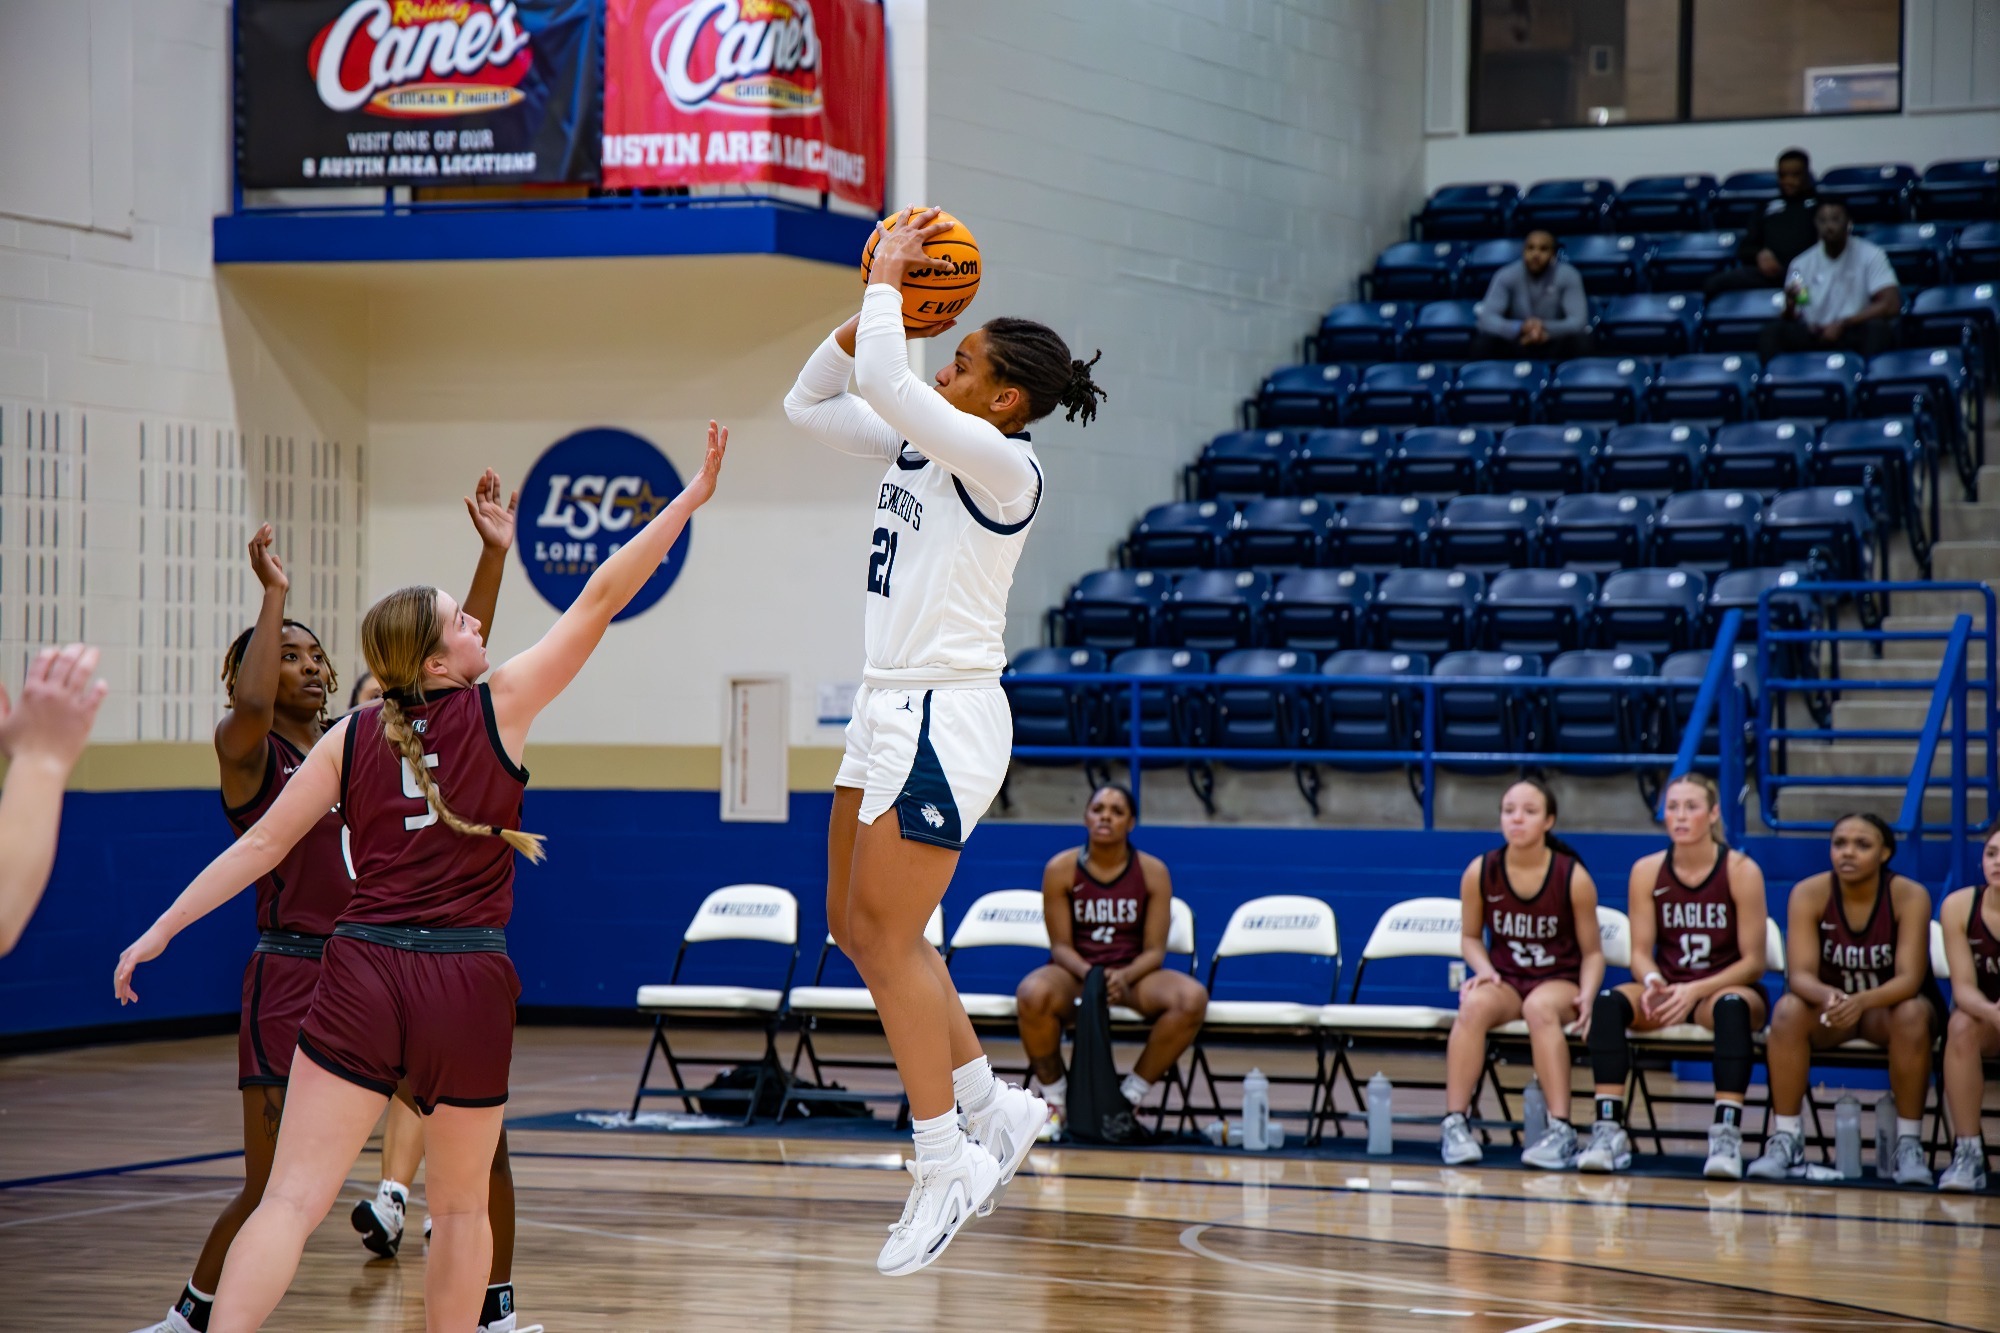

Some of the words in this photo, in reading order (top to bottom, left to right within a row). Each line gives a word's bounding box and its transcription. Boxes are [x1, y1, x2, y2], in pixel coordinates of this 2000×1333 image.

[347, 132, 391, 152] VISIT
[393, 130, 430, 151] ONE
[433, 130, 457, 151] OF
[459, 129, 494, 149] OUR
[318, 156, 386, 177] AUSTIN
[388, 155, 438, 175] AREA
[440, 153, 537, 175] LOCATIONS
[536, 474, 642, 540] LSC
[534, 542, 598, 562] LONE
[867, 527, 898, 598] 21
[401, 752, 440, 831] 5
[1073, 898, 1138, 923] EAGLES
[1492, 909, 1558, 939] EAGLES
[1662, 902, 1727, 929] EAGLES
[1677, 933, 1712, 969] 12
[1823, 939, 1894, 970] EAGLES
